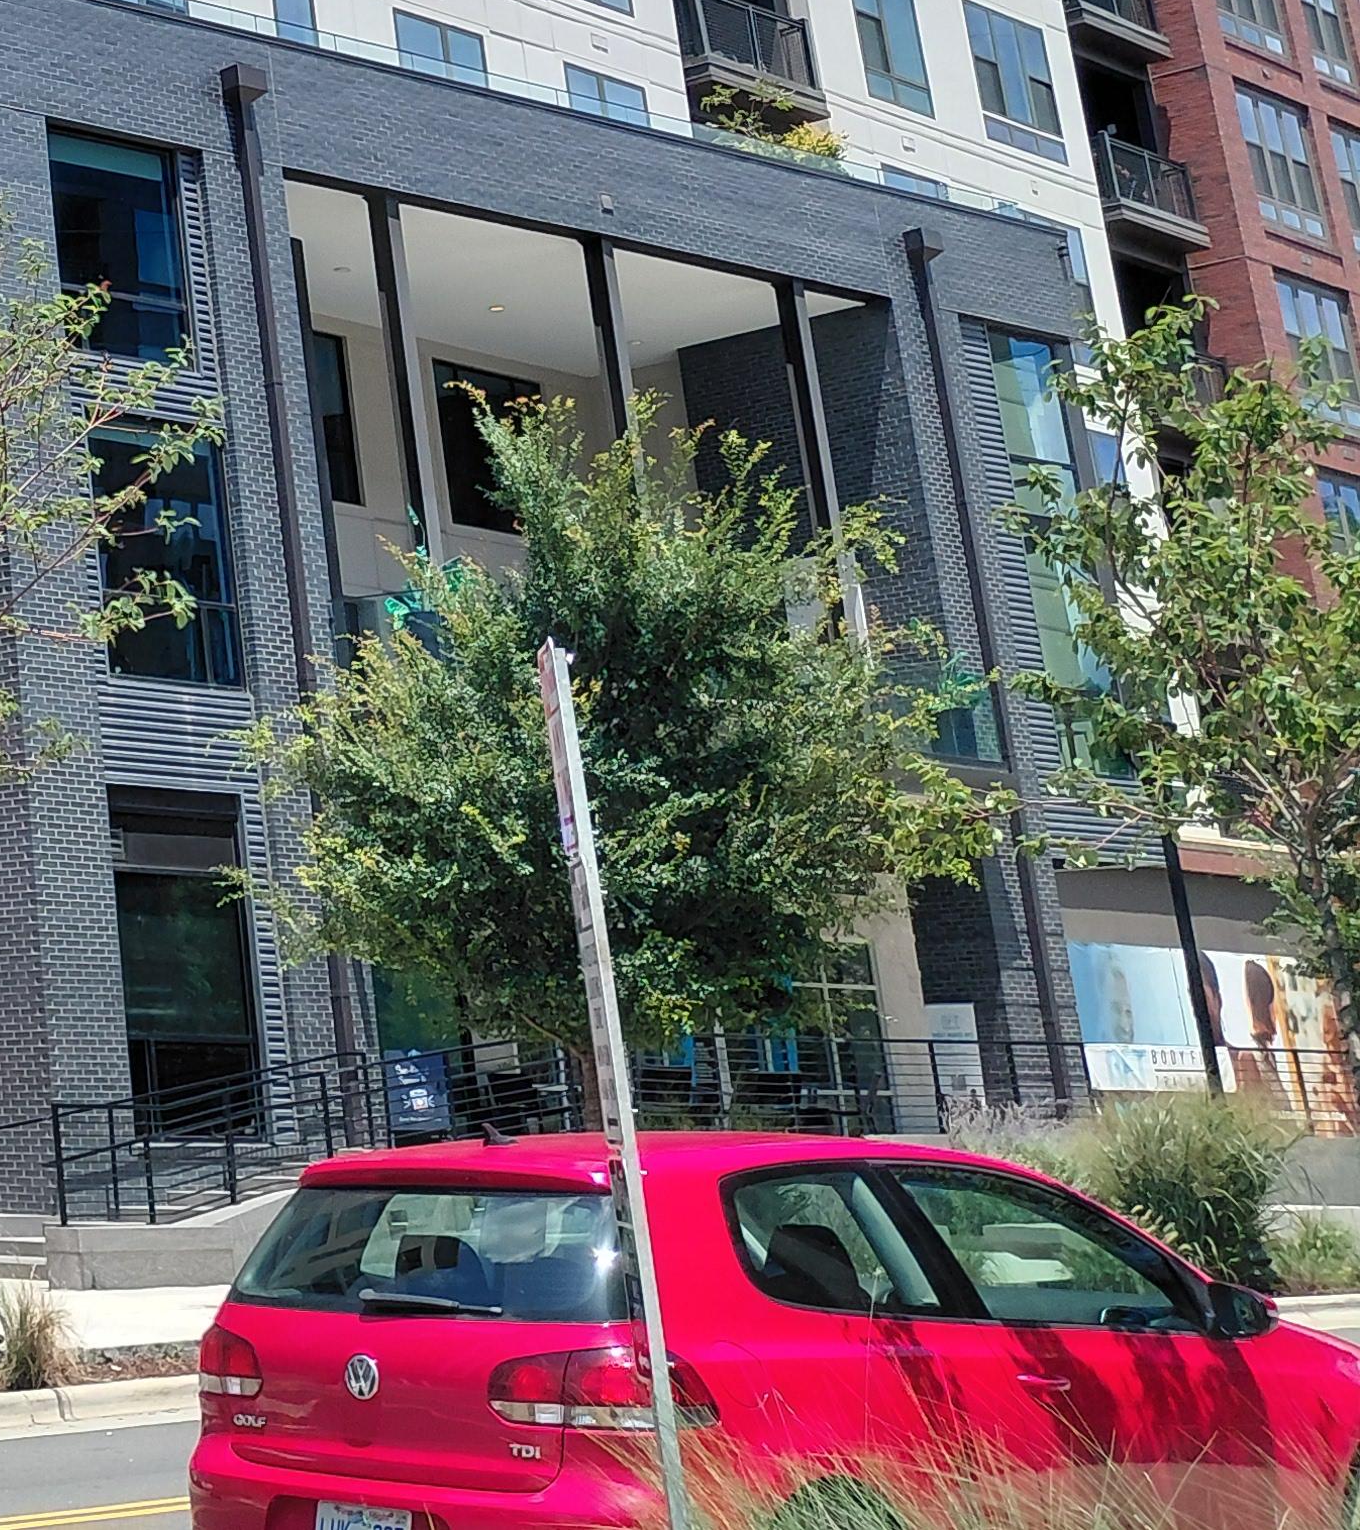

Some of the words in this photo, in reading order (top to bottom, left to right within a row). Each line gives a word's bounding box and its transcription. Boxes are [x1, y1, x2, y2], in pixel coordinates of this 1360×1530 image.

[1150, 1048, 1185, 1065] BODY
[232, 1413, 267, 1428] GOLF
[508, 1442, 542, 1460] TDI
